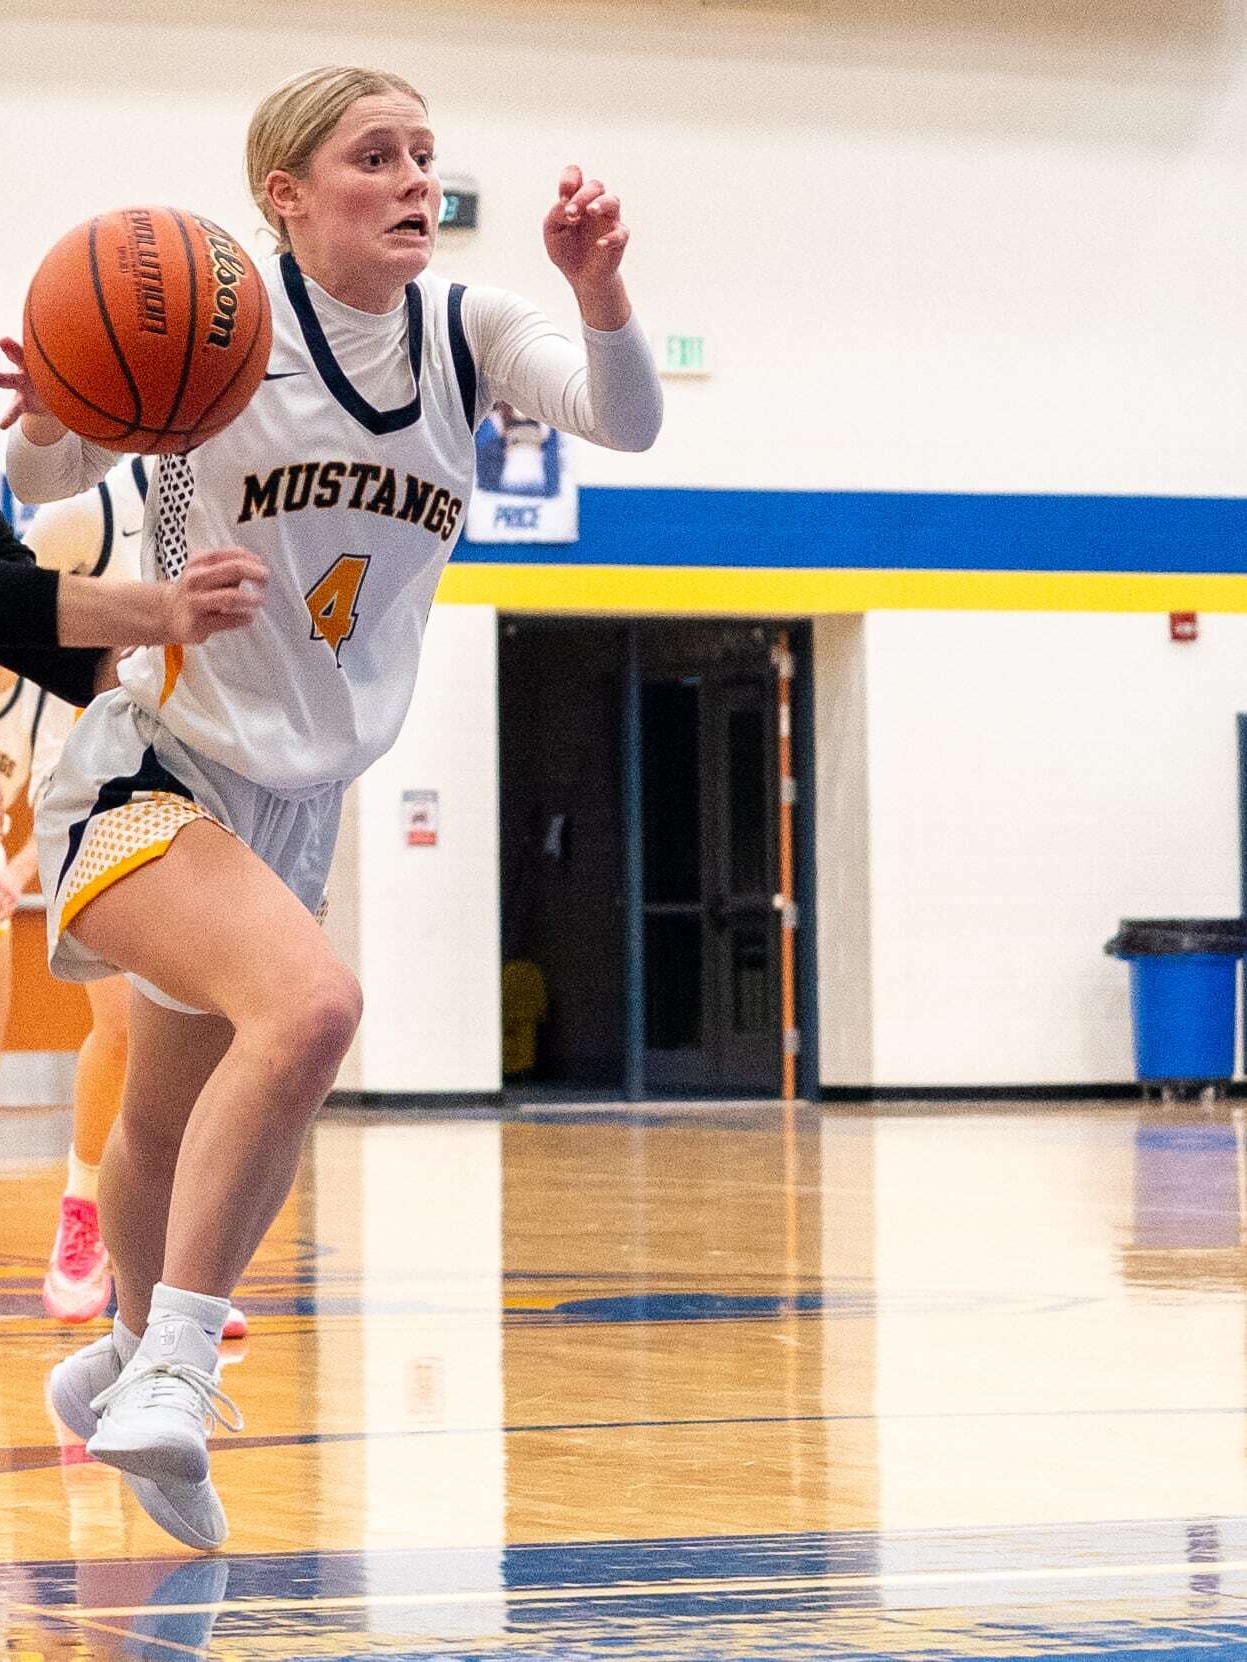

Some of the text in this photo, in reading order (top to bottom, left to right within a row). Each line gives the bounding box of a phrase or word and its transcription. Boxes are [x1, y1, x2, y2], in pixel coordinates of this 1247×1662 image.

[236, 461, 464, 543] MUSTANGS
[493, 504, 540, 530] PRICE
[303, 552, 372, 668] 4
